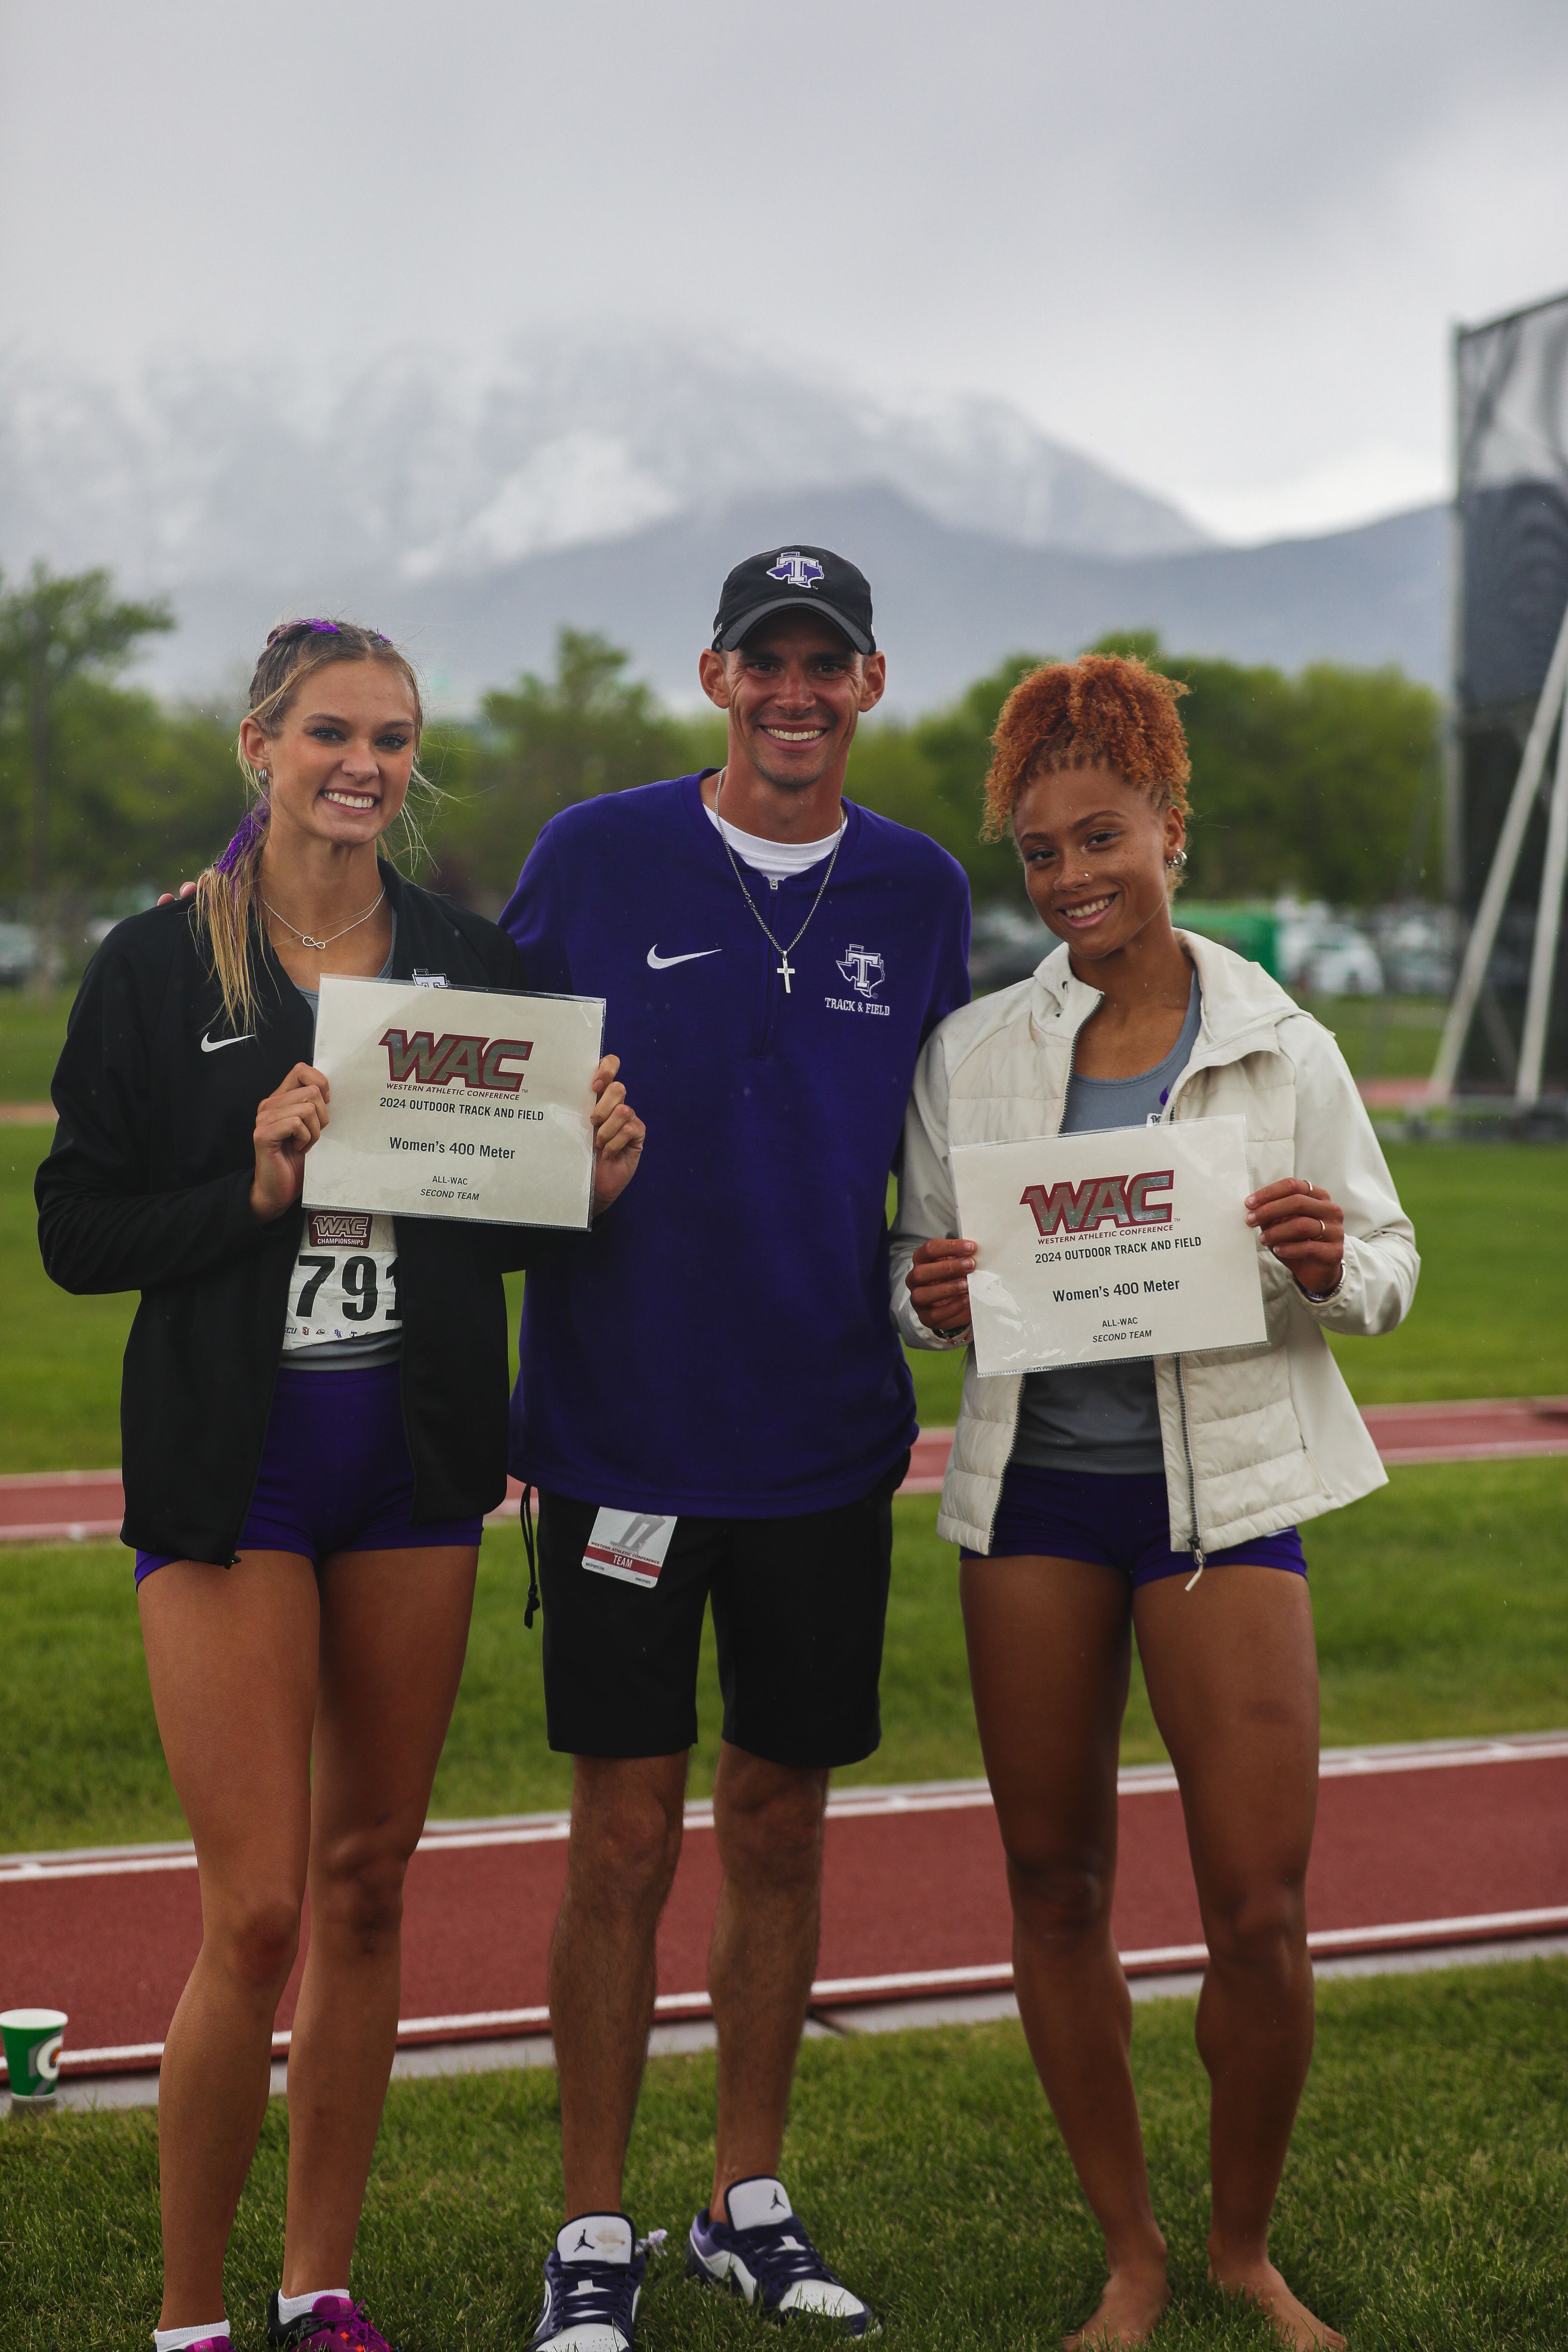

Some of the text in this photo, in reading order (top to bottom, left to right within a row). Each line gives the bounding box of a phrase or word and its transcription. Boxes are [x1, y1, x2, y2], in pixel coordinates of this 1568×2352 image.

[825, 997, 890, 1016] TRACK & FIELD
[378, 1028, 534, 1092] WAC
[386, 1083, 520, 1101] WESTERN ATHLETIC CONFERENCE
[379, 1097, 544, 1121] 2024 OUTDOOR TRACK AND FIELD
[389, 1136, 515, 1159] Women's 400 Meter
[432, 1176, 468, 1185] ALL-WAC
[420, 1188, 480, 1201] SECOND TEAM
[1019, 1169, 1175, 1236] WAC
[312, 1216, 369, 1237] WAC
[1037, 1225, 1174, 1245] WESTERN ATHLETIC CONFERENCE
[1035, 1236, 1201, 1264] 2024 OUTDOOR TRACK AND FIELD
[1053, 1279, 1180, 1302] Women's 400 Meter
[1102, 1317, 1138, 1327] ALL-WAC
[1092, 1329, 1152, 1343] SECOND TEAM
[591, 1542, 660, 1565] WESTERN ATHLETIC CONFERENCE
[613, 1554, 633, 1568] TEAM
